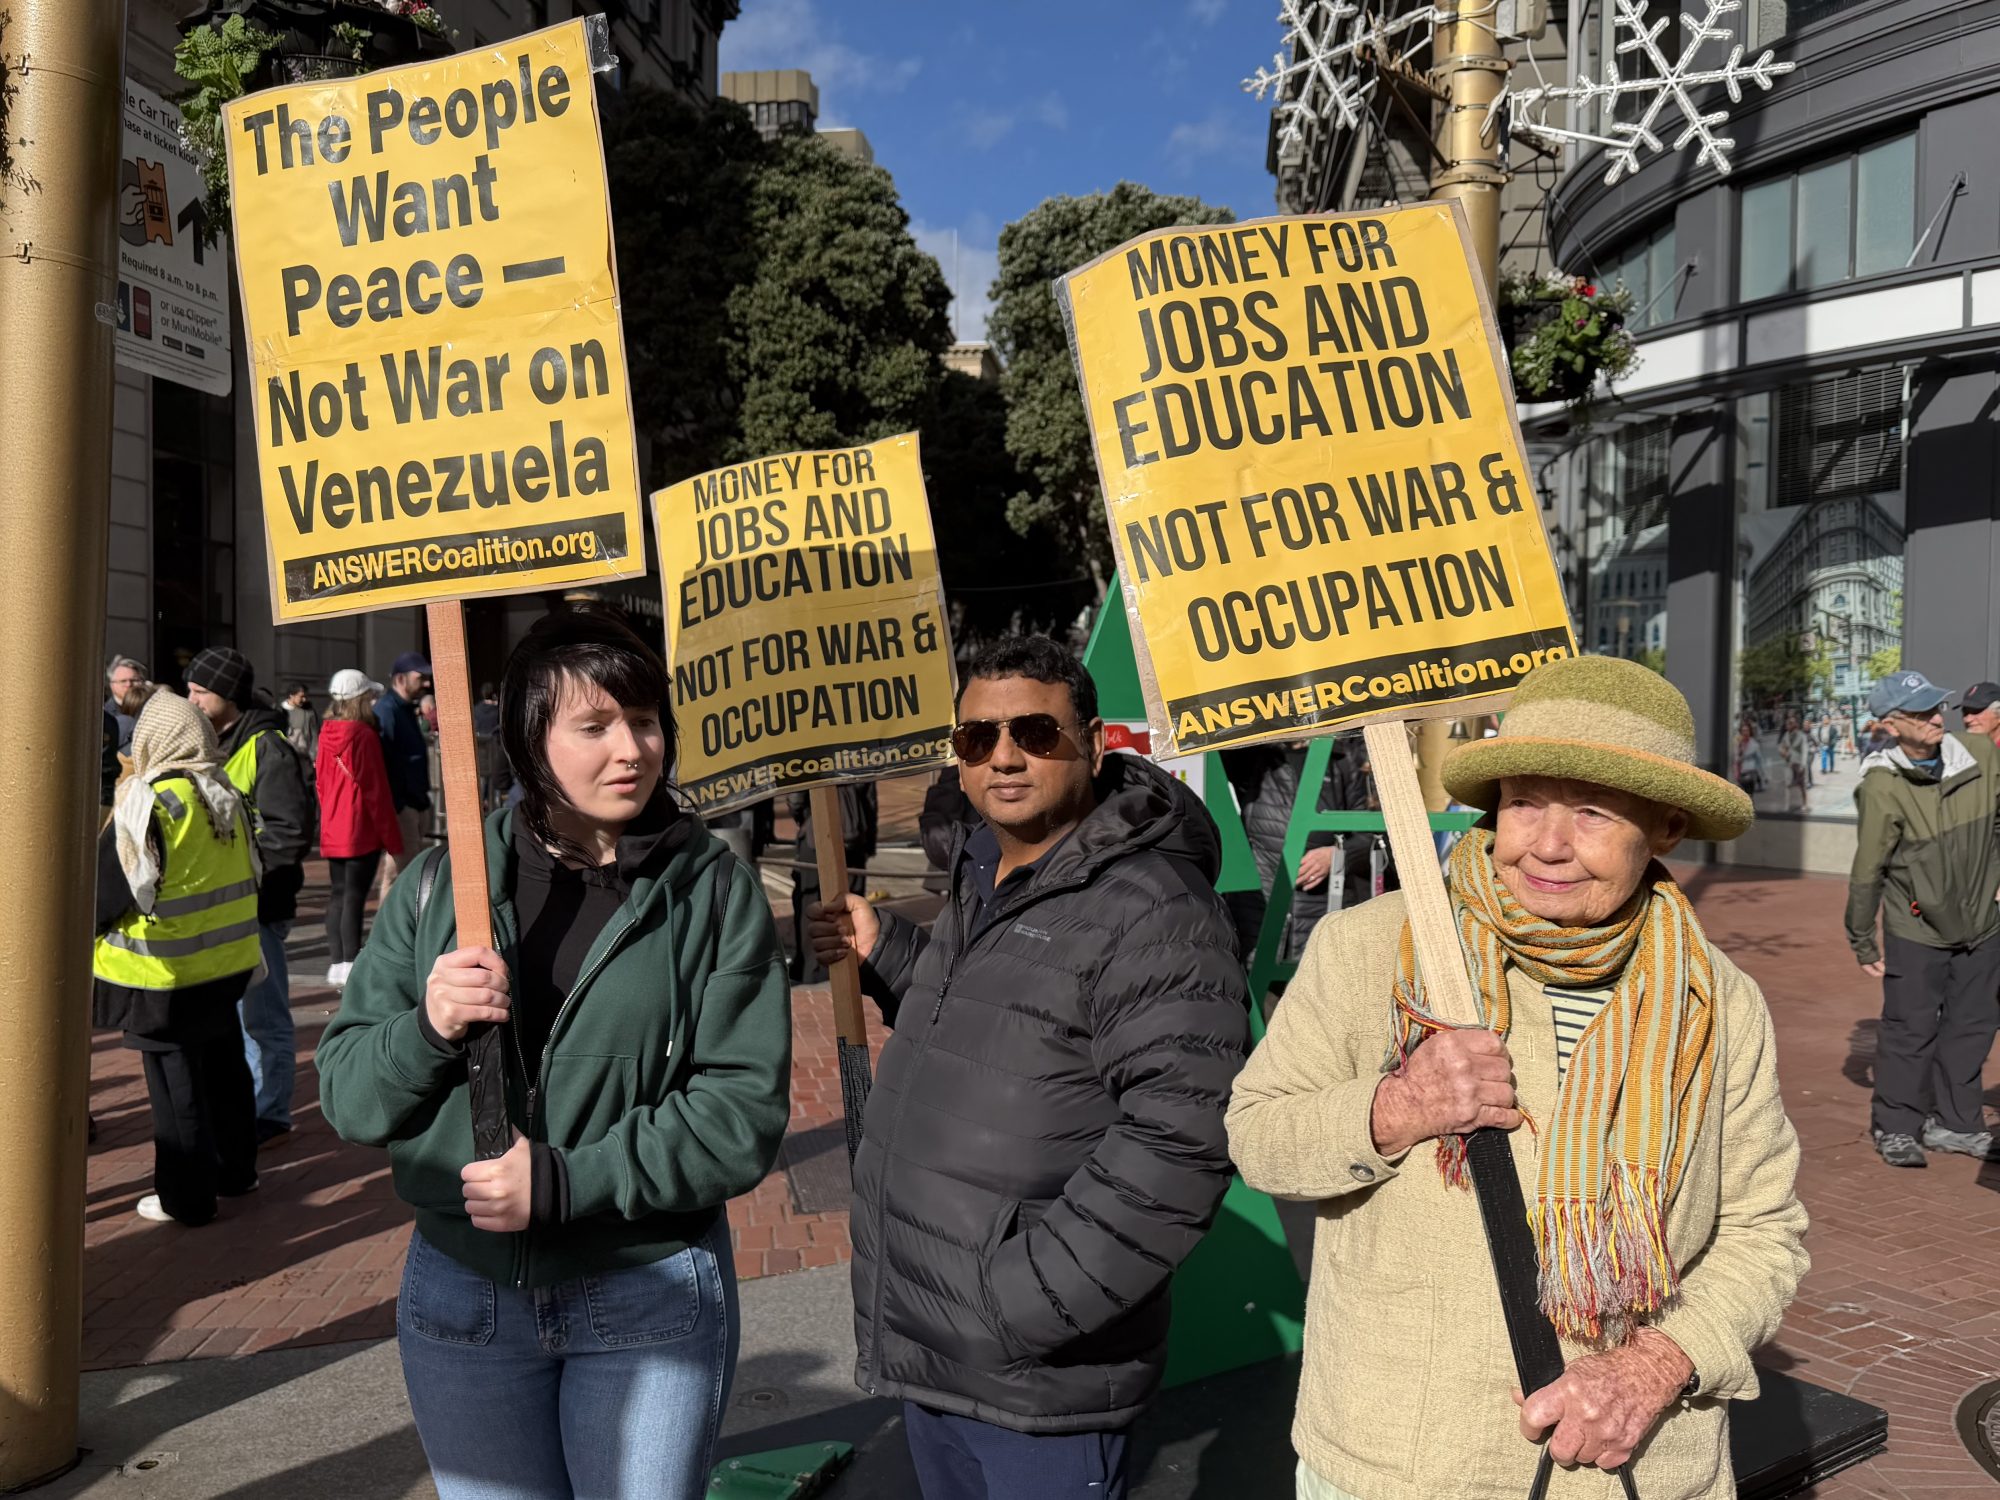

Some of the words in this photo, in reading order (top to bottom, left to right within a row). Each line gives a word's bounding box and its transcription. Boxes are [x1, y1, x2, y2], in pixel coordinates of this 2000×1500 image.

[139, 98, 158, 121] Car
[144, 129, 152, 143] at
[154, 135, 177, 157] ticket
[244, 102, 352, 175] The
[366, 53, 571, 154] People
[328, 154, 500, 247] Want
[121, 251, 159, 277] Required
[160, 268, 166, 280] 8
[167, 273, 184, 288] a.m.
[186, 280, 195, 292] to
[195, 283, 202, 295] 8
[202, 286, 219, 302] p.m.
[281, 253, 484, 338] Peace
[1126, 224, 1290, 301] MONEY
[1303, 218, 1398, 274] FOR
[160, 300, 169, 311] or
[171, 305, 185, 318] use
[160, 316, 170, 328] or
[1137, 290, 1289, 384] JOBS
[1304, 276, 1431, 357] AND
[268, 362, 369, 448] Not
[380, 345, 511, 425] War
[529, 338, 610, 405] on
[1112, 347, 1473, 469] EDUCATION
[278, 420, 610, 535] Venezuela
[693, 456, 802, 514] MONEY
[812, 448, 877, 488] FOR
[1125, 500, 1232, 584] NOT
[1240, 482, 1350, 558] FOR
[1348, 461, 1477, 537] WAR
[1479, 452, 1524, 516] &
[313, 529, 597, 590] ANSWERCoalition.org
[695, 499, 790, 570] JOBS
[803, 487, 893, 542] AND
[679, 532, 914, 630] EDUCATION
[1187, 545, 1515, 662] OCCUPATION
[675, 644, 734, 707] NOT
[742, 629, 811, 682] FOR
[817, 617, 905, 667] WAR
[911, 612, 938, 655] &
[1177, 645, 1568, 741] ANSWERCoalition.org
[701, 674, 920, 758] OCCUPATION
